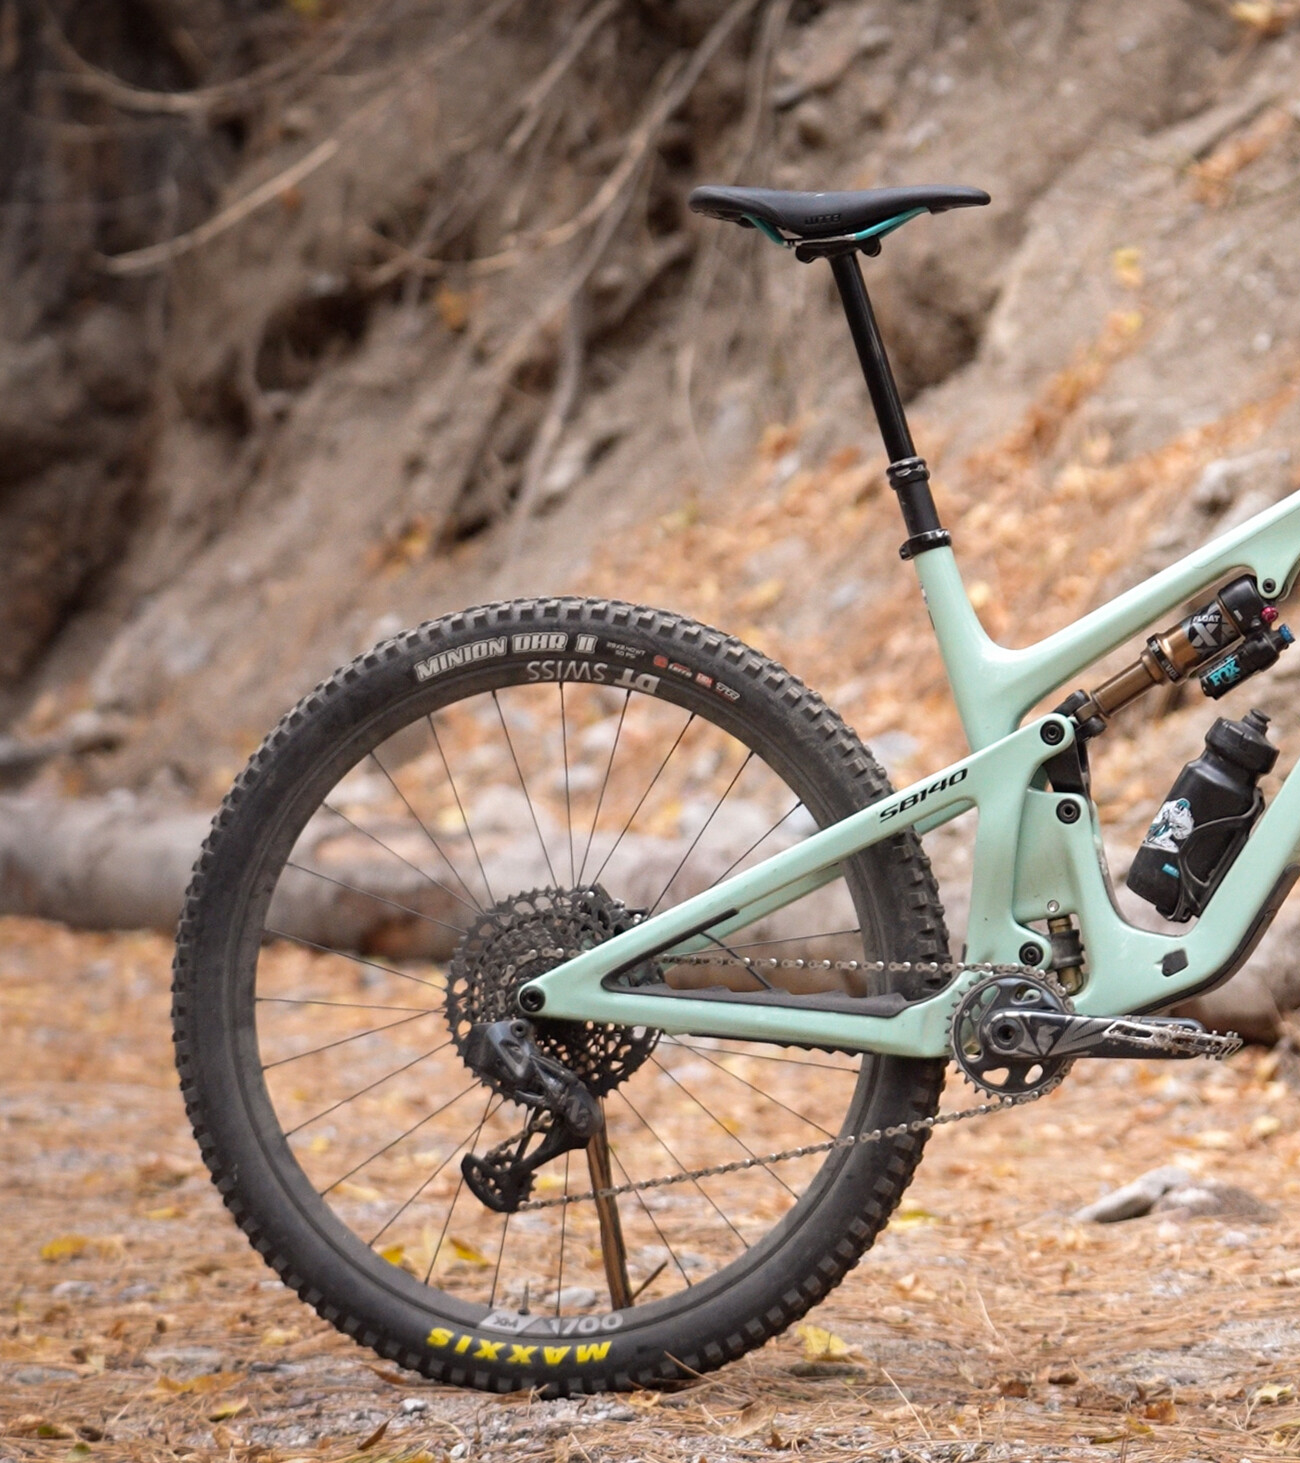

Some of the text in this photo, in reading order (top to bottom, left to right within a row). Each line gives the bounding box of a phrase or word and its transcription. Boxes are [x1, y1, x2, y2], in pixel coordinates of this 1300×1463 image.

[1193, 614, 1220, 623] FLOAT
[413, 631, 598, 683] MINION DHR II
[1209, 659, 1241, 686] FOX
[526, 660, 661, 694] DT SWISS
[880, 768, 968, 823] SB140
[550, 1312, 624, 1336] 1700
[426, 1327, 613, 1366] MAXXIS
